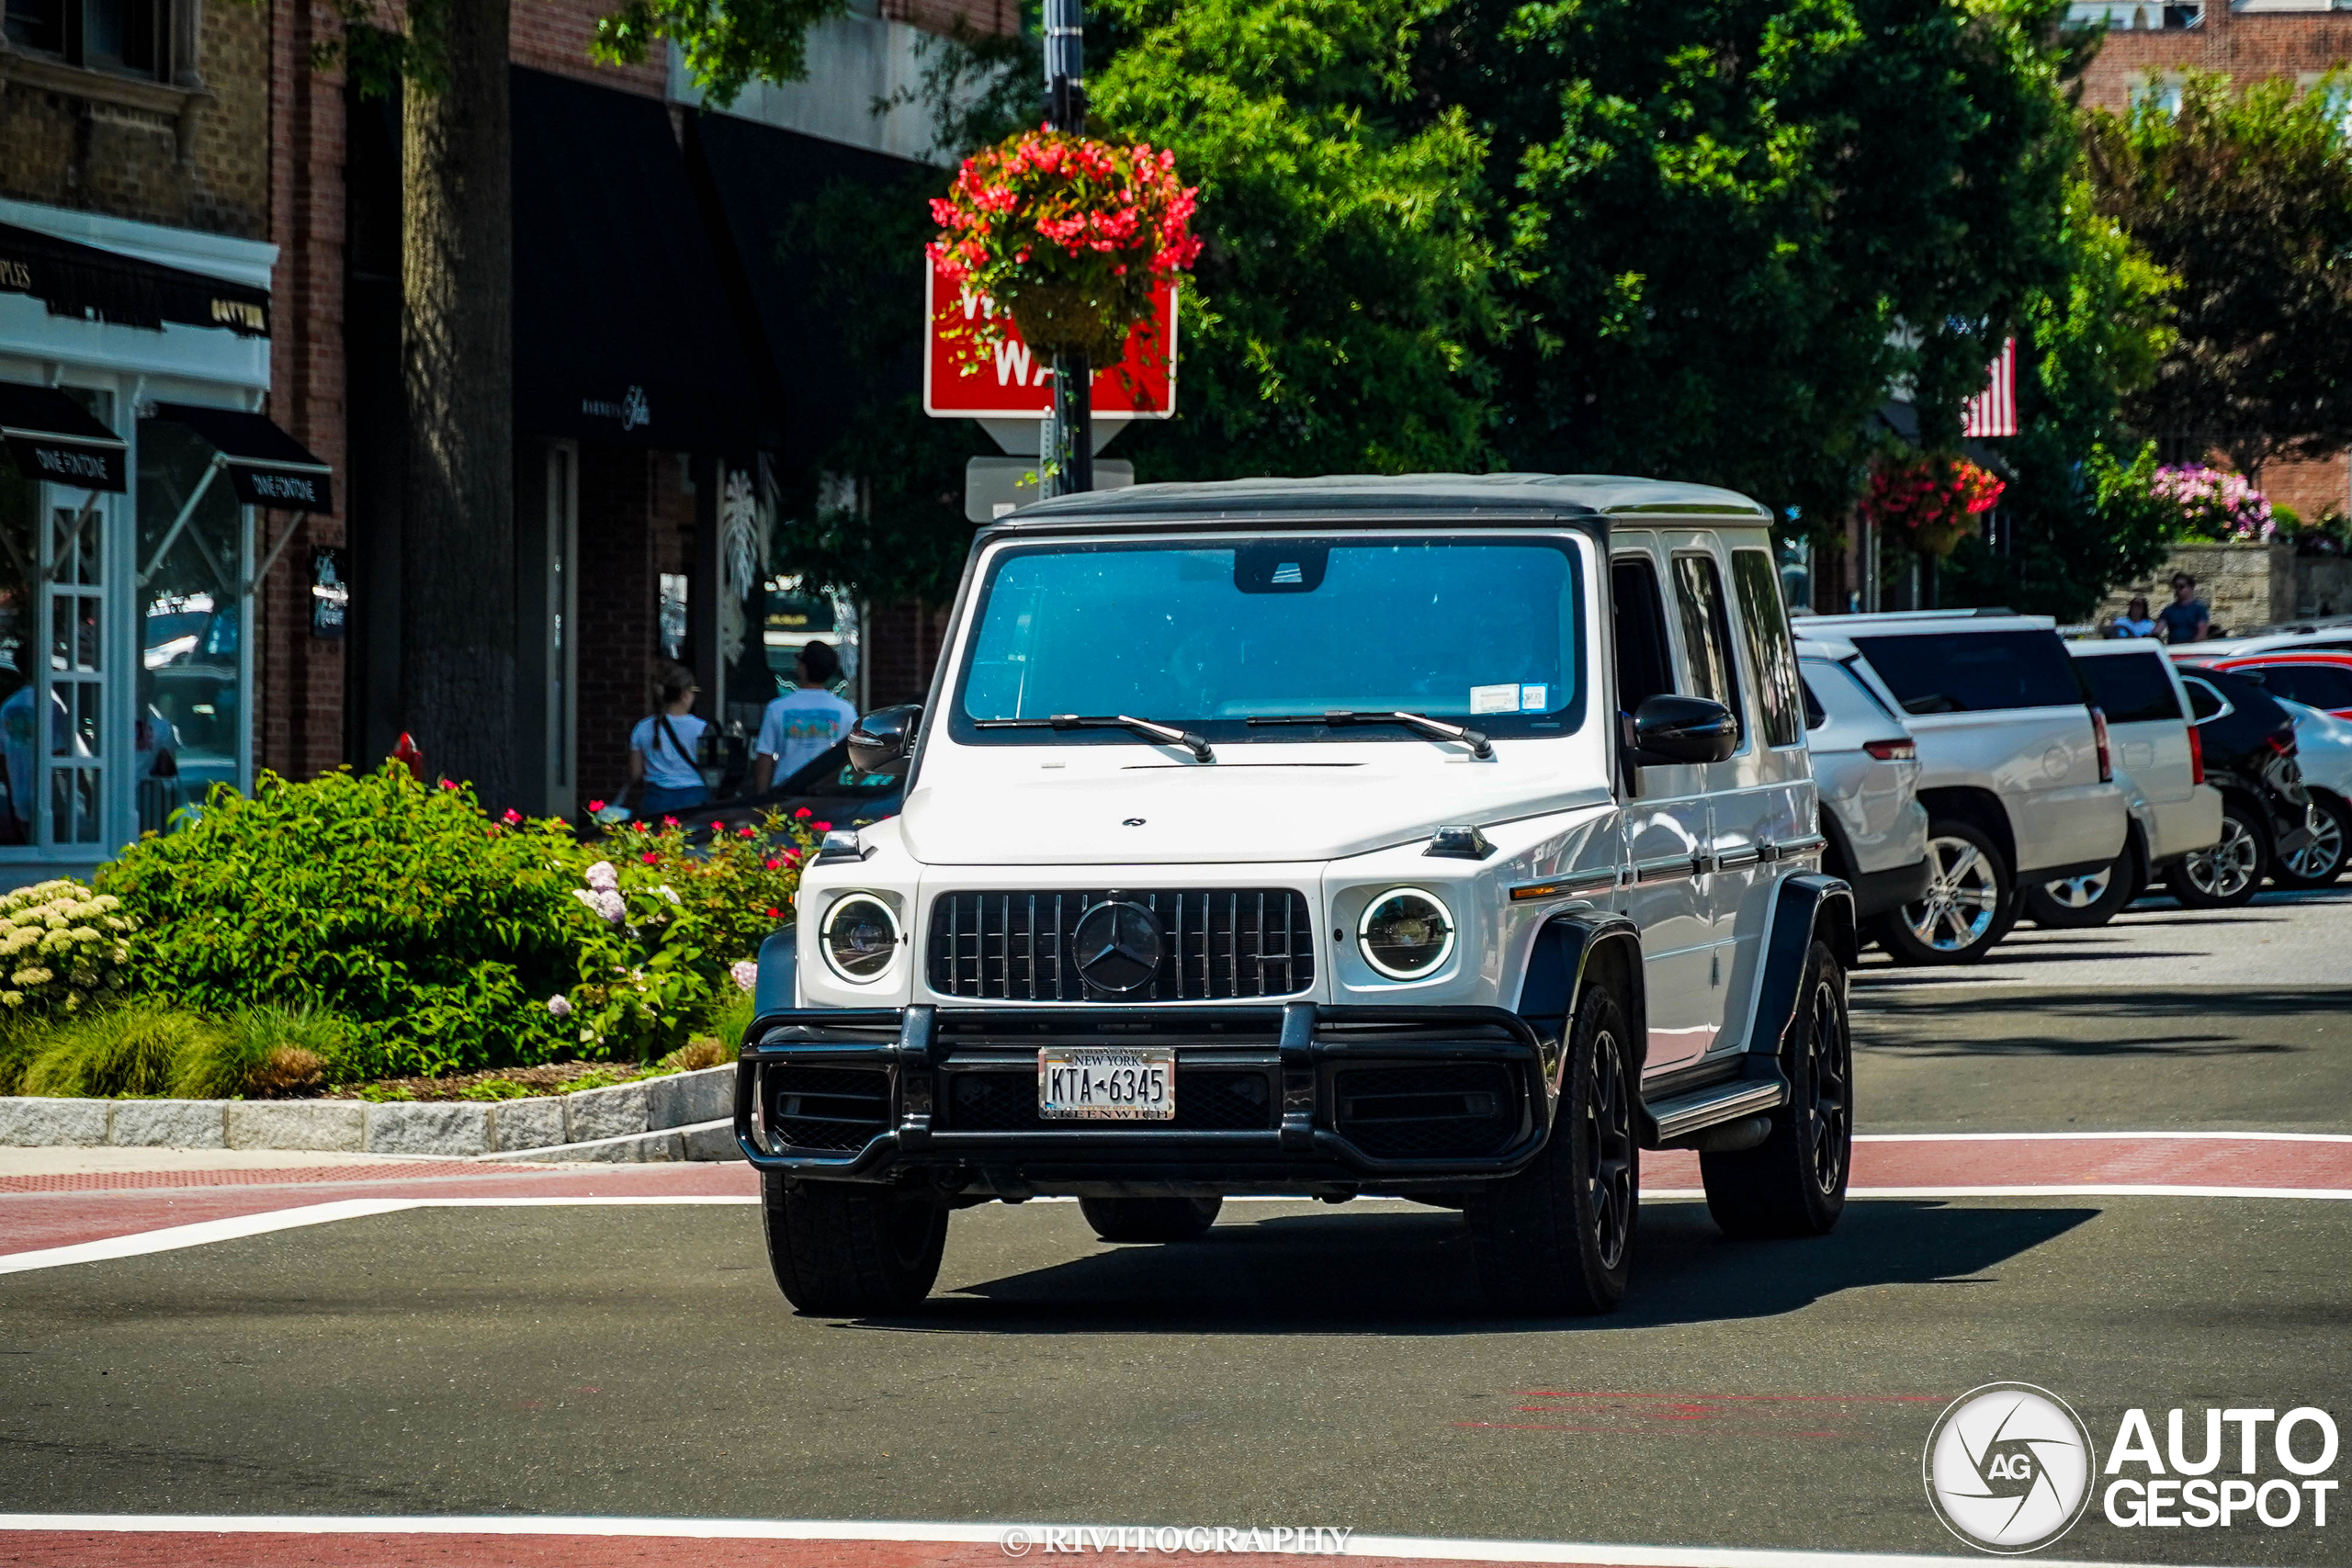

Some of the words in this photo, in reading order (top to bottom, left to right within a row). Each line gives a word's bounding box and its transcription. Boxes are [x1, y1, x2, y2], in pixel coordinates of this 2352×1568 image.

[1074, 1055, 1103, 1066] NEW
[1106, 1055, 1140, 1066] YORK
[1051, 1067, 1092, 1102] KTA
[1109, 1067, 1164, 1102] 6345
[1045, 1110, 1169, 1119] GREENWICH
